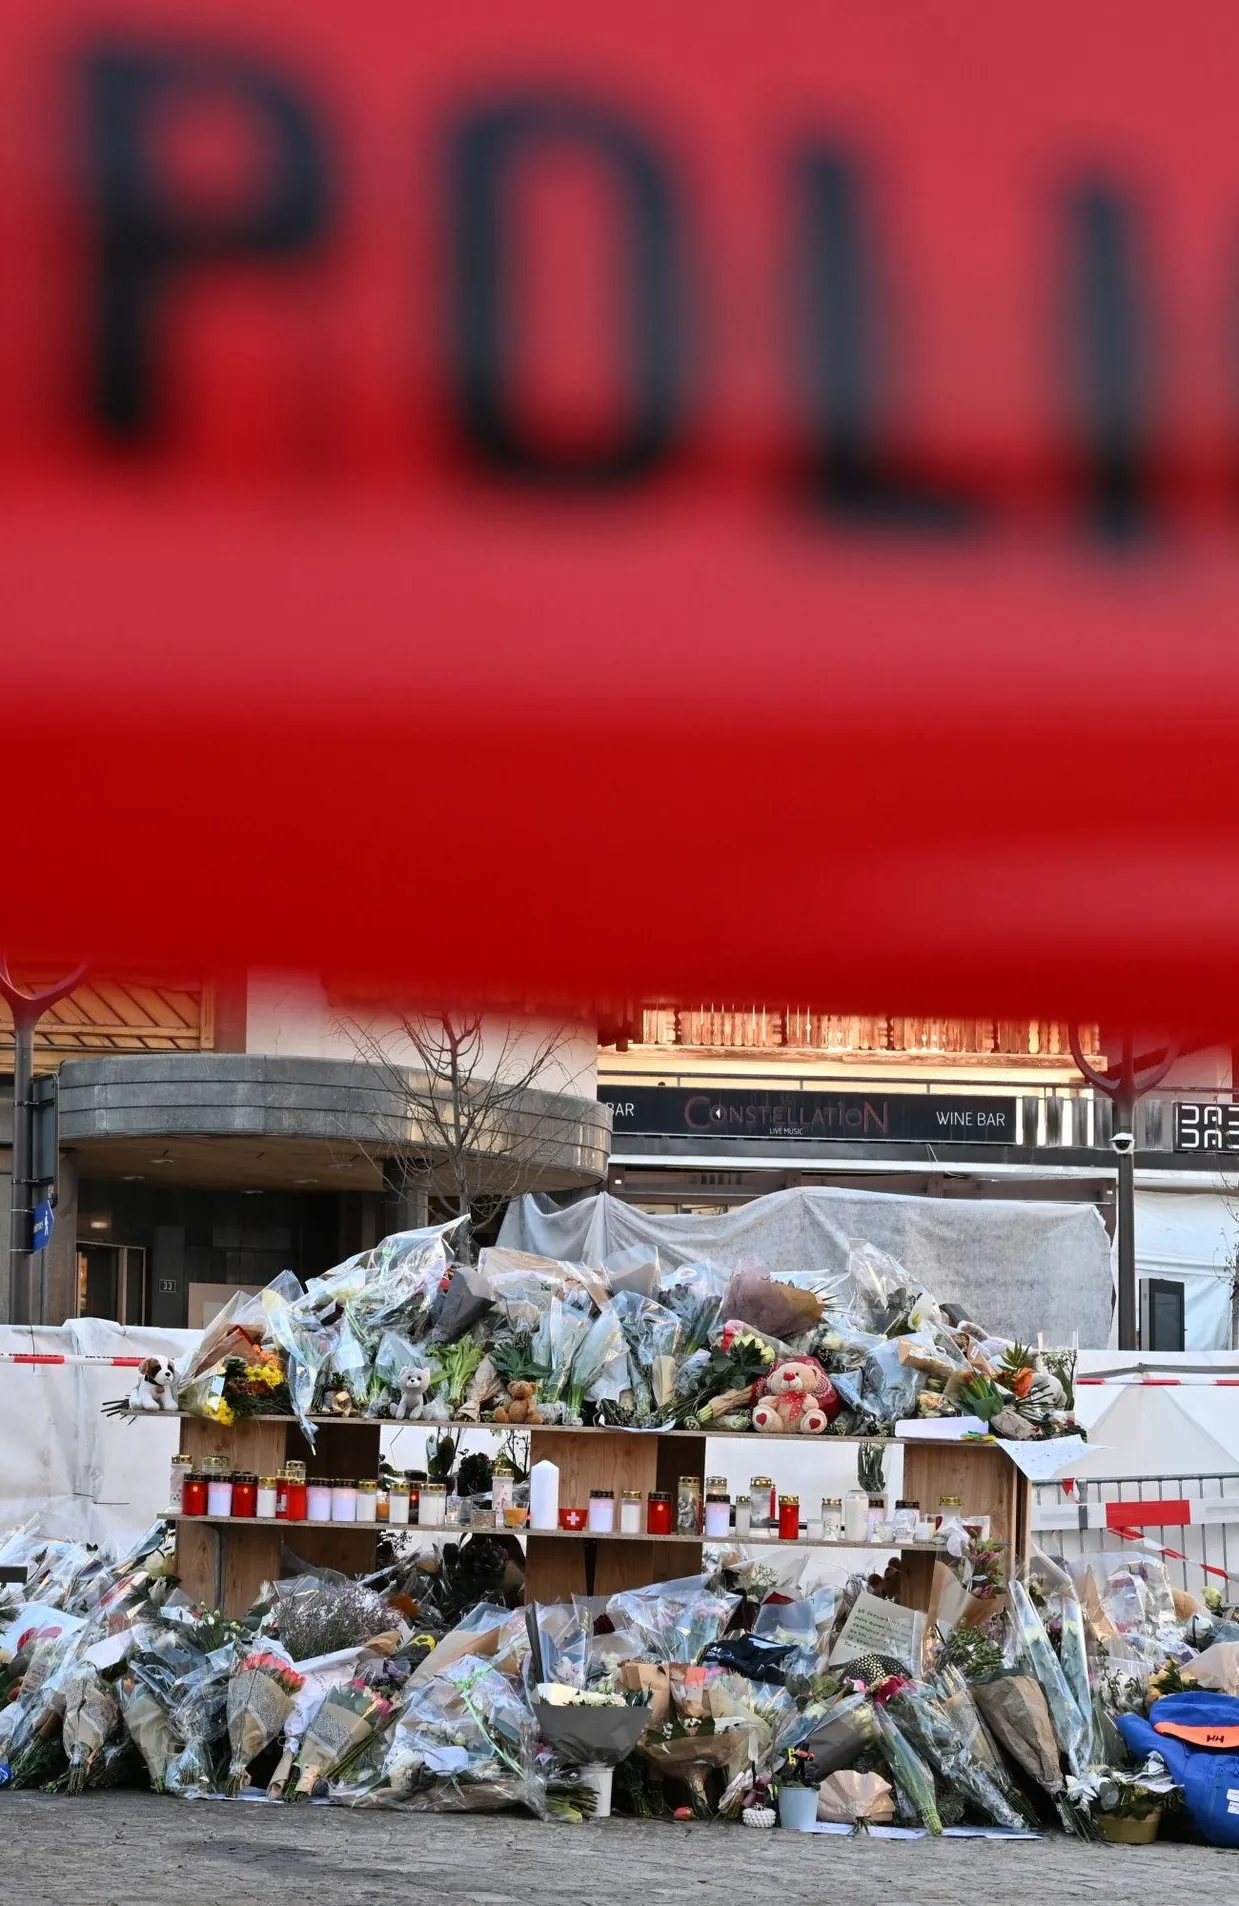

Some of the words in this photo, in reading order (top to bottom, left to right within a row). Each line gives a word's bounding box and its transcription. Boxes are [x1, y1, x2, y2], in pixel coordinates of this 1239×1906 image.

[72, 38, 1239, 553] POLI
[936, 1111, 973, 1126] WINE
[977, 1112, 1006, 1127] BAR
[784, 1128, 804, 1136] MUSIC
[163, 1281, 173, 1291] 33
